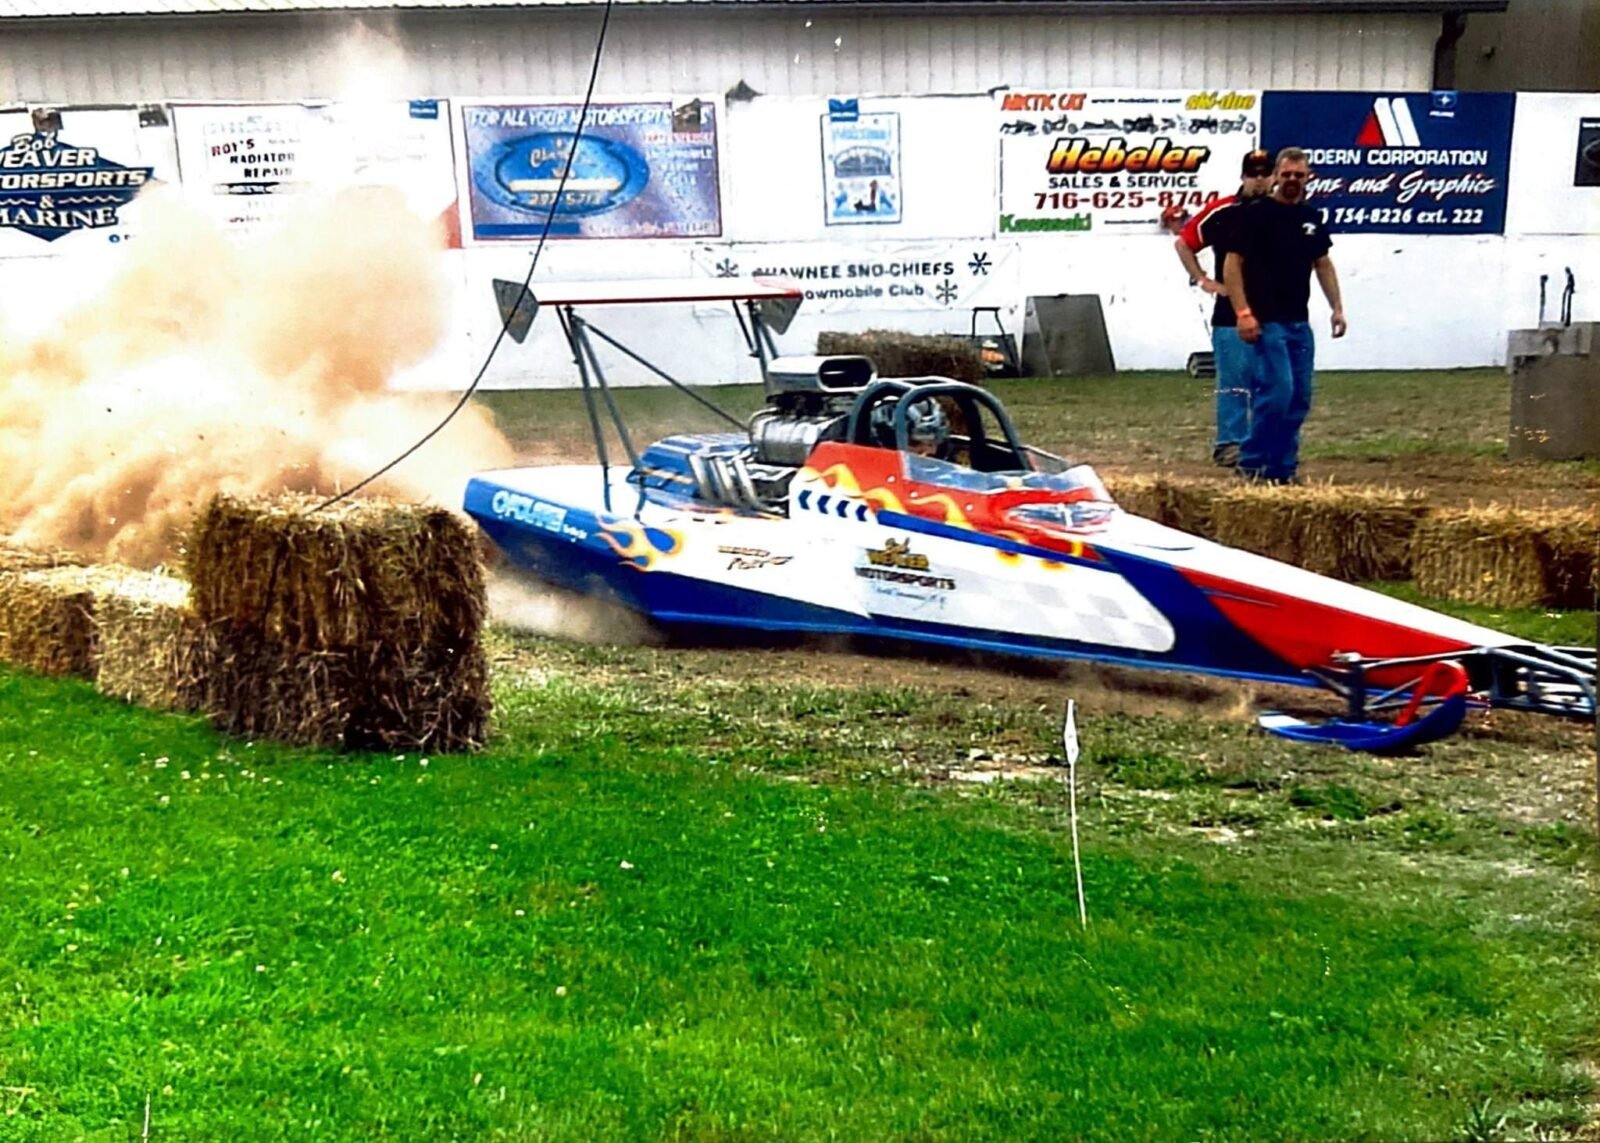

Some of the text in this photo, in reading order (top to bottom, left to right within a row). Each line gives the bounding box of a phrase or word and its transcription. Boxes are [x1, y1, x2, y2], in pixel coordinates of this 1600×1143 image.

[501, 109, 528, 127] ALL
[529, 109, 568, 126] YOUR
[11, 131, 55, 153] Bob
[0, 149, 97, 168] EAVER
[1046, 137, 1211, 174] Hebeler
[1301, 149, 1487, 165] ODERN CORPORATION
[0, 170, 148, 189] ORSPORTS
[1048, 175, 1199, 188] SALES & SERVICE
[1348, 172, 1397, 193] and
[1397, 169, 1496, 203] Graphics
[39, 195, 55, 209] &
[1334, 207, 1413, 224] 754-8226
[1416, 208, 1448, 224] ext.
[1451, 208, 1484, 224] 222
[847, 262, 955, 278] SNO-CHIEFS
[888, 284, 925, 297] Club
